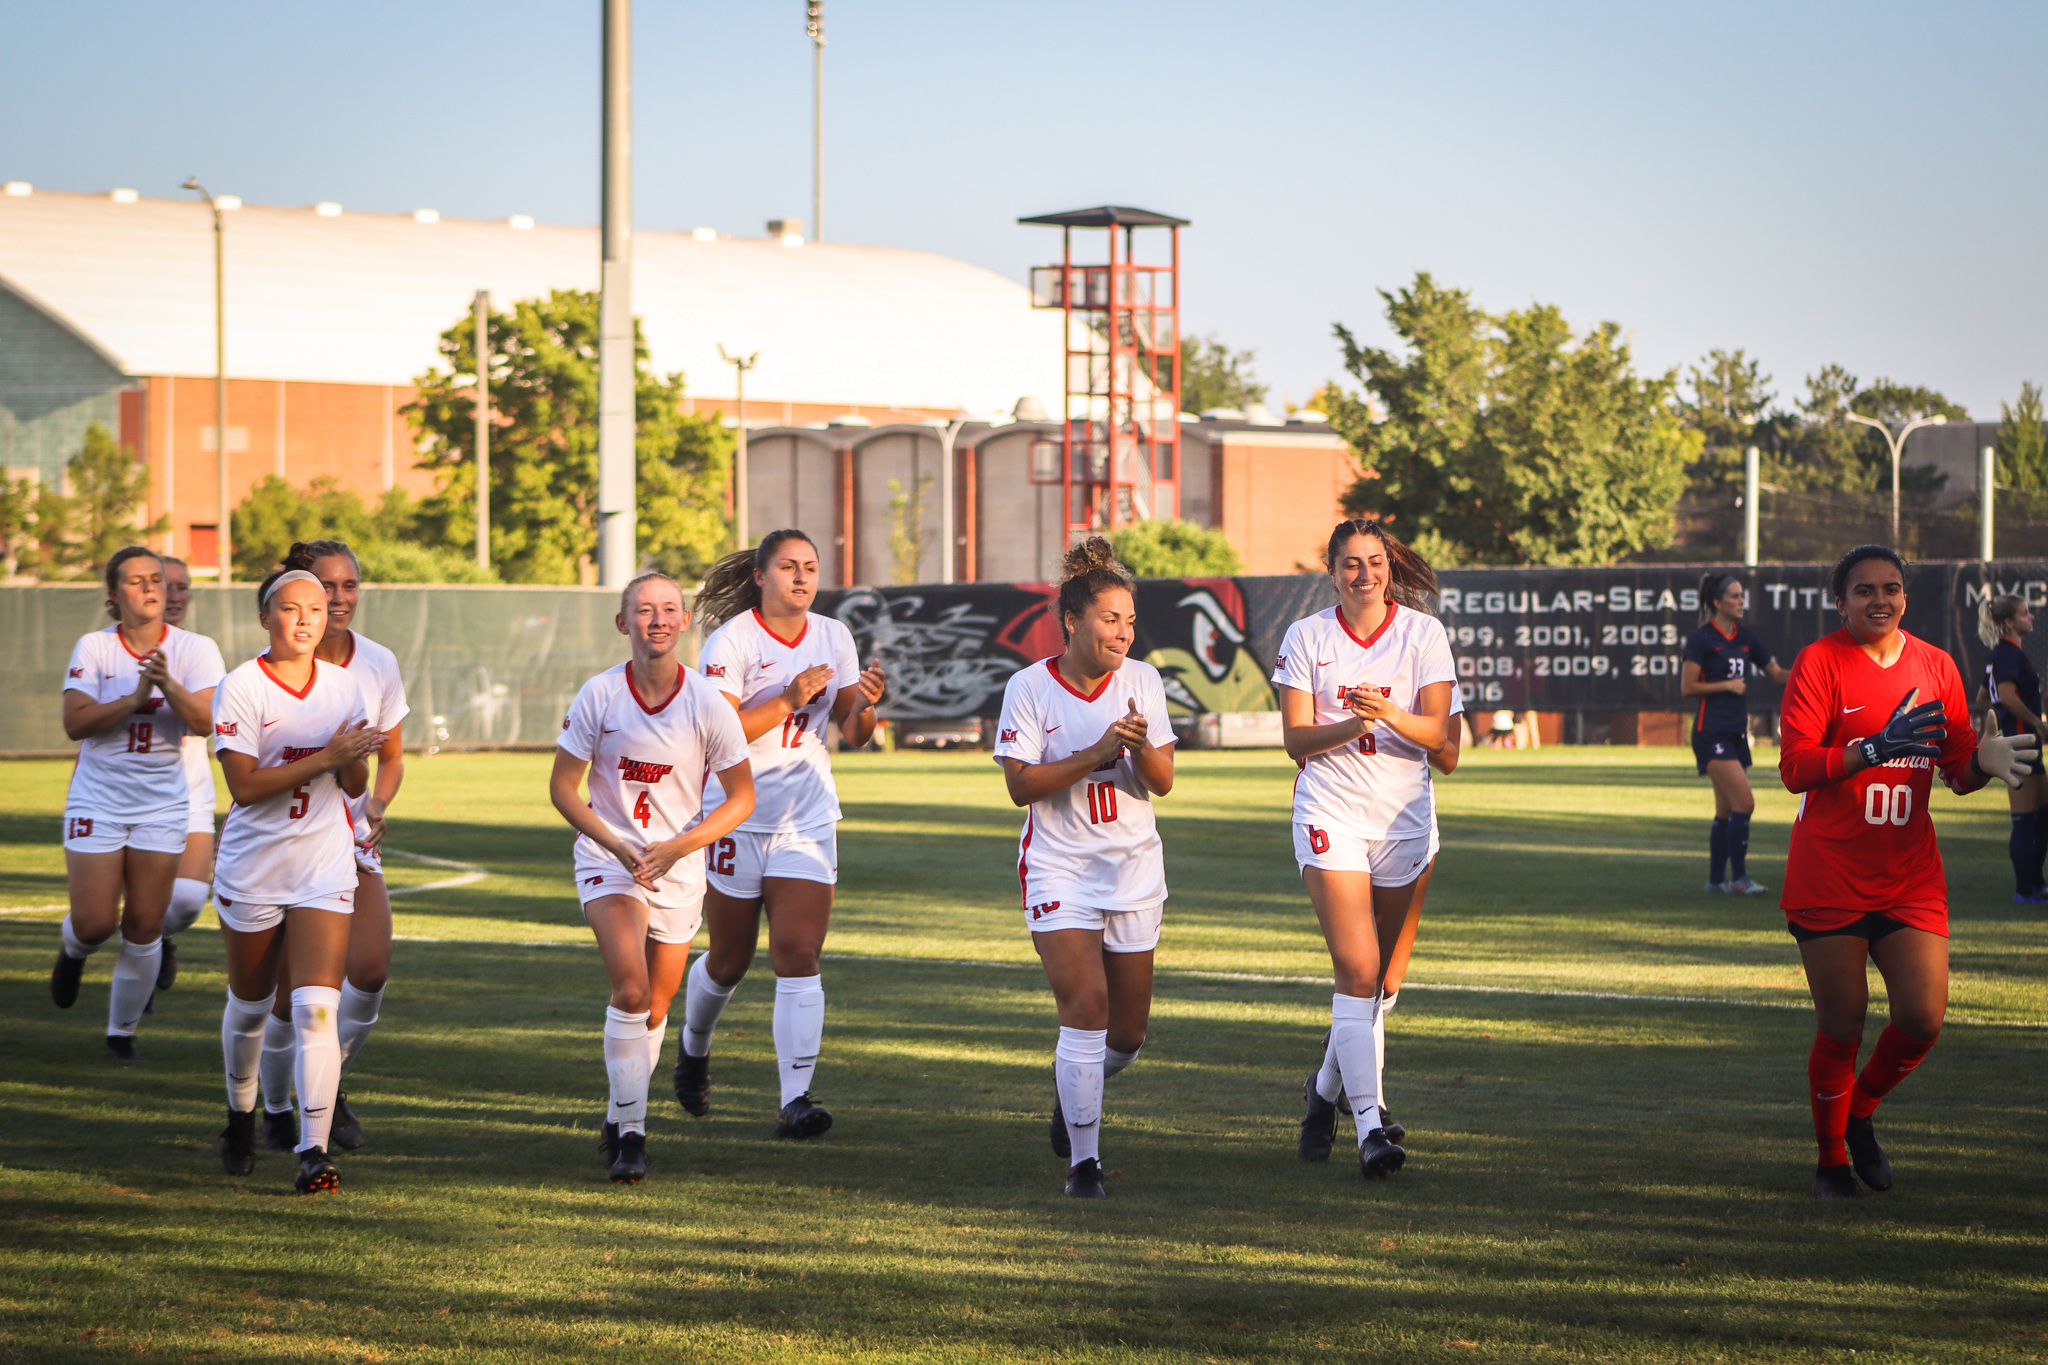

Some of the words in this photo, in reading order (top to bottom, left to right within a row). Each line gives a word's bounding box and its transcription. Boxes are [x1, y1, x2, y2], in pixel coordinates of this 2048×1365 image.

[1439, 587, 1749, 613] REGULAR-SEAS
[1765, 584, 1838, 610] TITL
[1515, 626, 1590, 647] 2001,
[1602, 625, 1687, 646] 2003,
[1457, 655, 1522, 679] 008,
[1534, 655, 1619, 679] 2009,
[1727, 657, 1745, 679] 33
[1460, 681, 1503, 702] 016
[127, 722, 153, 753] 19
[781, 712, 810, 749] 12
[618, 756, 674, 775] ILLINOIS
[622, 769, 662, 784] STATE
[290, 781, 311, 820] 5
[633, 790, 651, 829] 4
[1086, 780, 1118, 825] 10
[1864, 782, 1913, 826] 00
[1308, 825, 1331, 855] 6
[707, 837, 737, 877] 12
